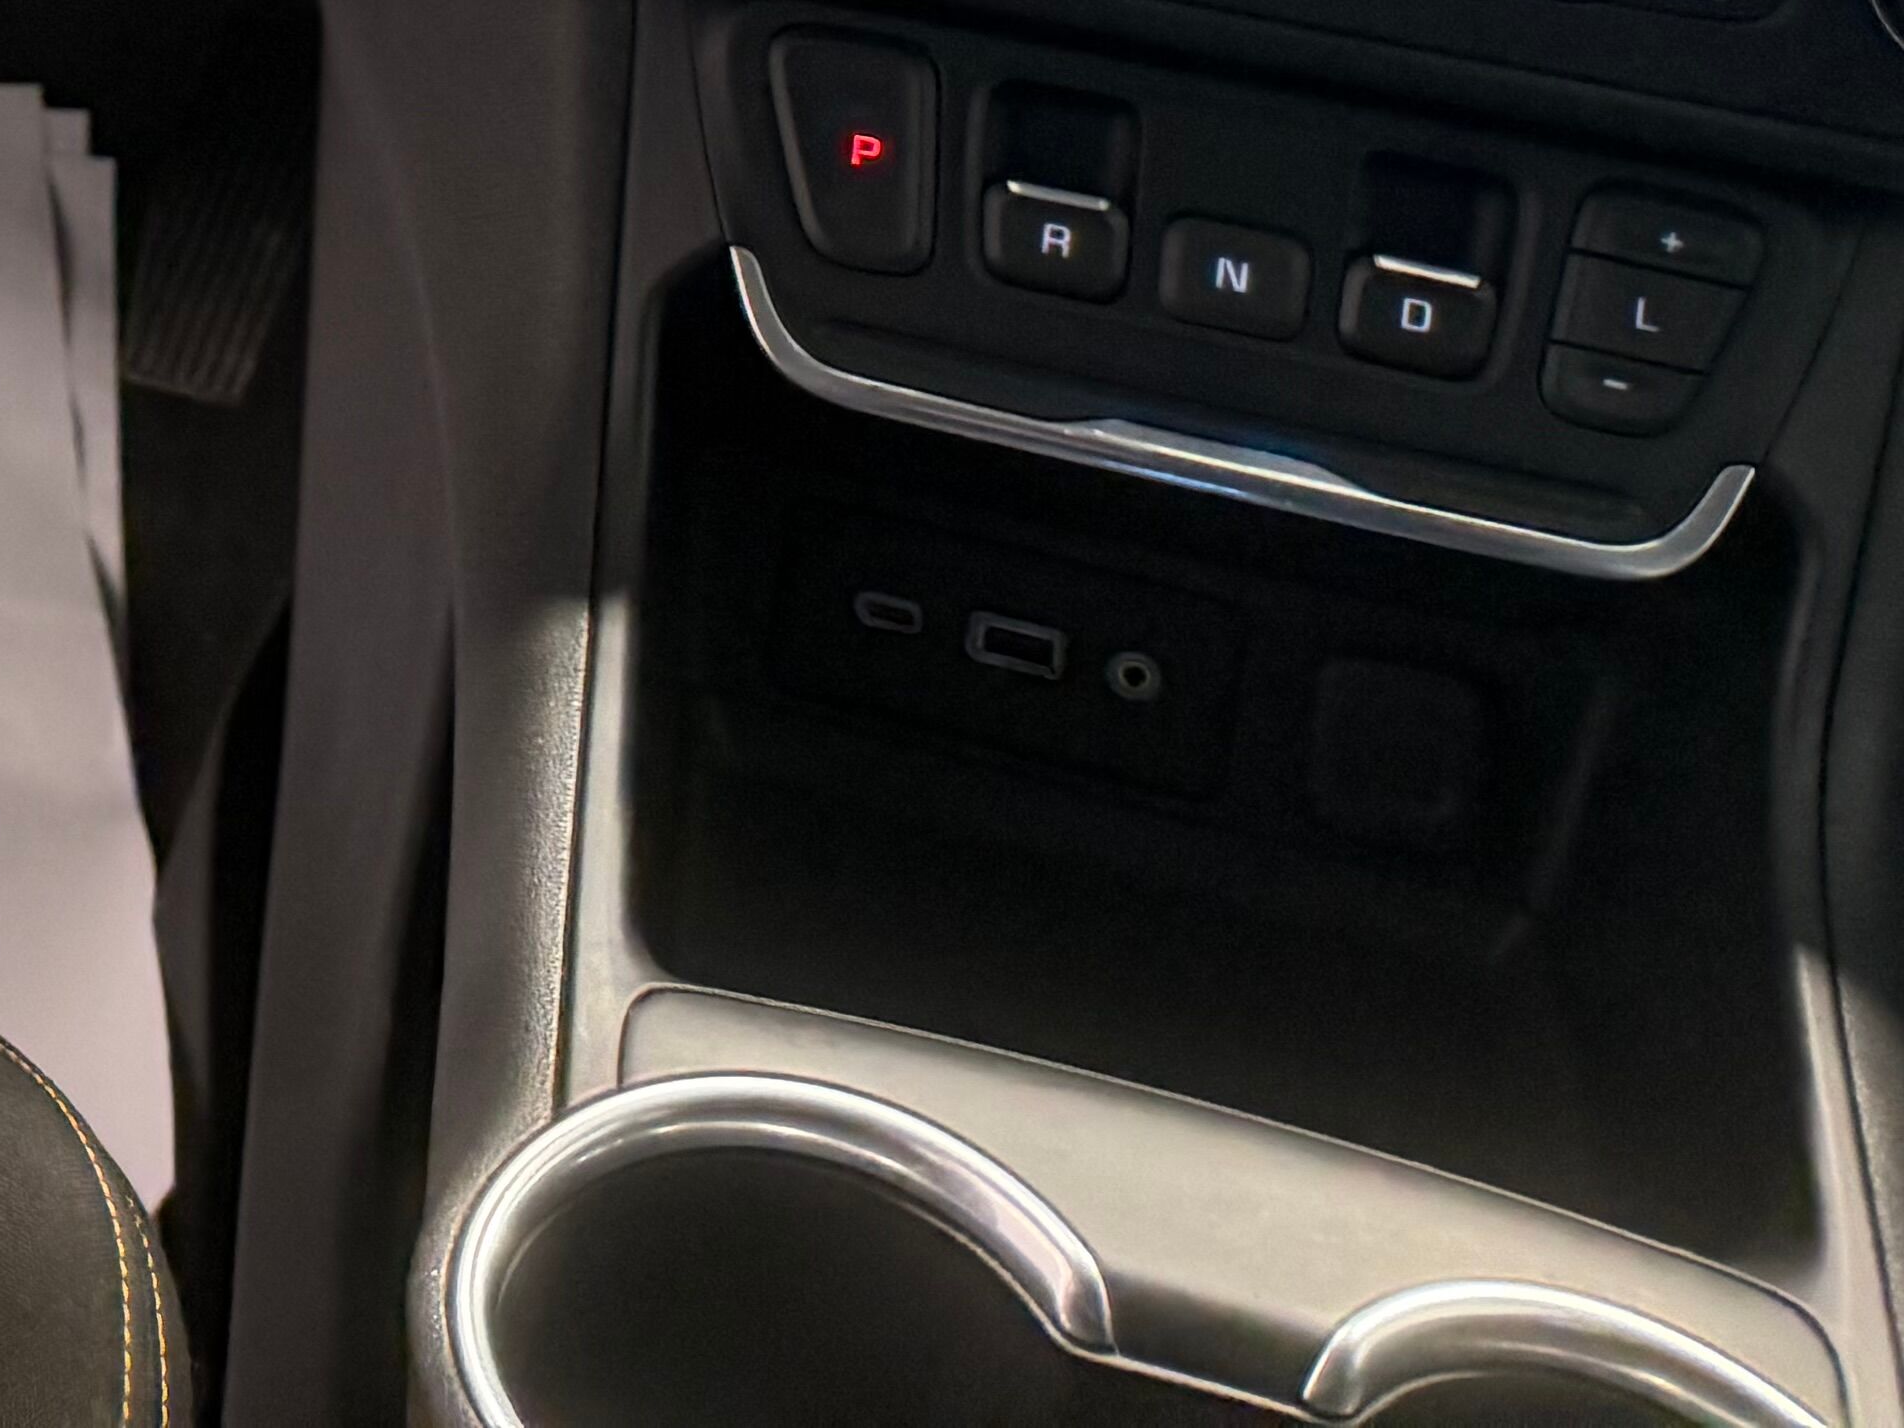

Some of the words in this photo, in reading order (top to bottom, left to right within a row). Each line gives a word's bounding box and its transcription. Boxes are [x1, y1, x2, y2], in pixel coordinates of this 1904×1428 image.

[850, 132, 882, 167] P
[1041, 221, 1072, 259] R
[1215, 257, 1249, 294] N
[1401, 297, 1433, 334] D
[1636, 296, 1660, 334] L
